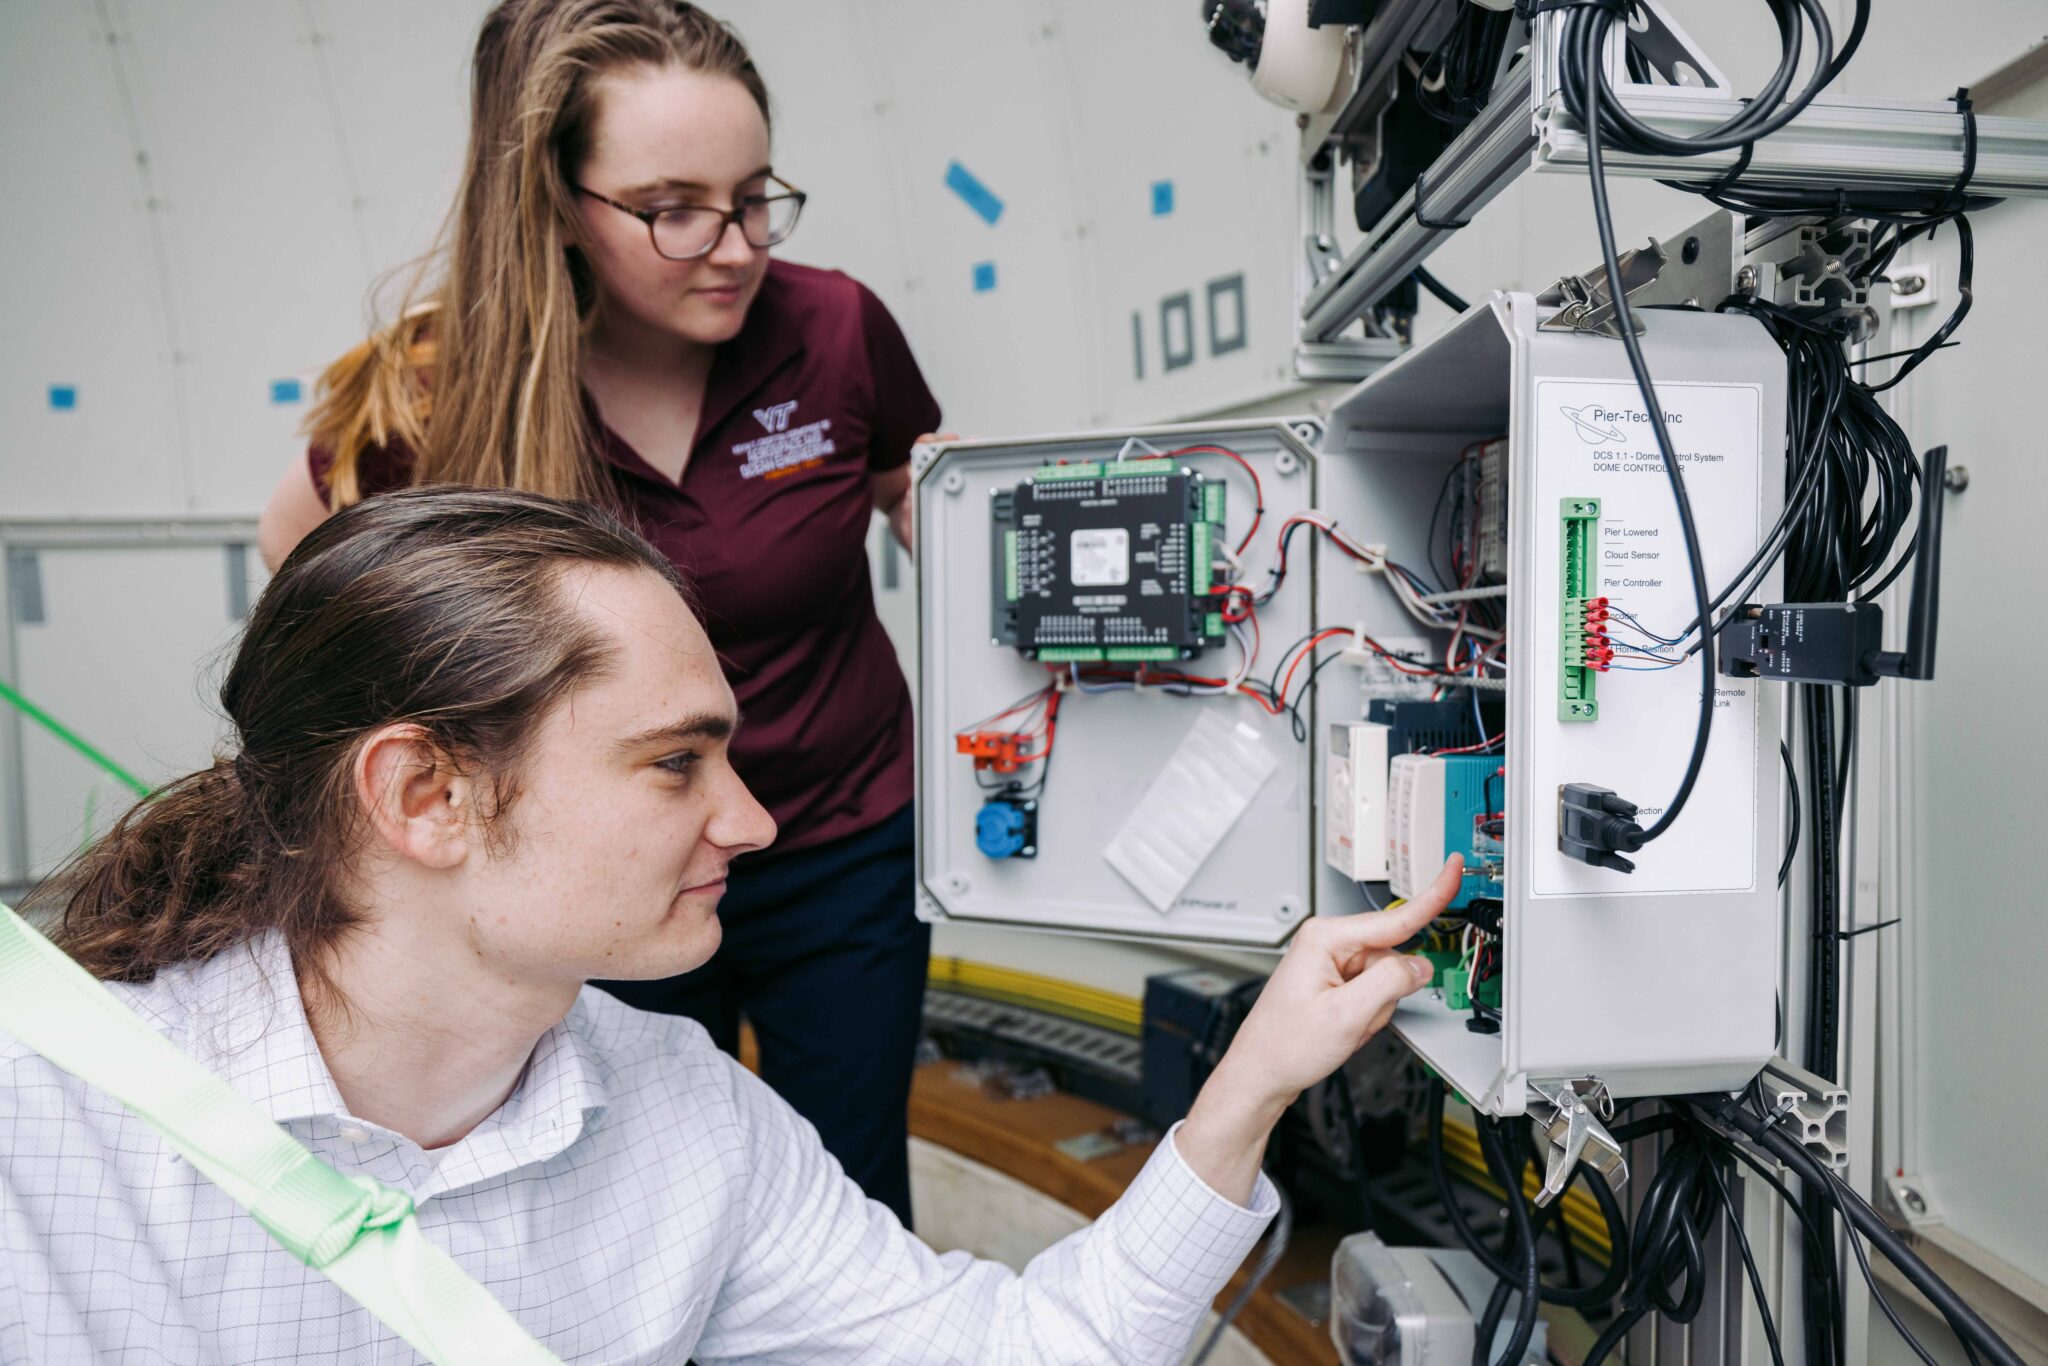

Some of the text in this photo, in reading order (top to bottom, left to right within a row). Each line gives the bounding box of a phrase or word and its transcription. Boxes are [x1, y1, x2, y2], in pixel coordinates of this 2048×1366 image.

[753, 400, 798, 432] VT
[1664, 411, 1683, 423] Inc
[1594, 451, 1613, 461] DCS
[1616, 451, 1628, 460] 1.1
[1636, 452, 1660, 461] Dome
[1669, 452, 1692, 462] ntrol
[1694, 453, 1724, 464] System
[1594, 463, 1685, 473] DOME CONTROLR
[1605, 528, 1658, 537] Pier Lowered
[1605, 551, 1660, 560] Cloud Sensor
[1605, 579, 1662, 588] Pier Controller
[1608, 612, 1638, 620] ncoder
[1714, 688, 1746, 697] Remote
[1714, 699, 1731, 708] Link
